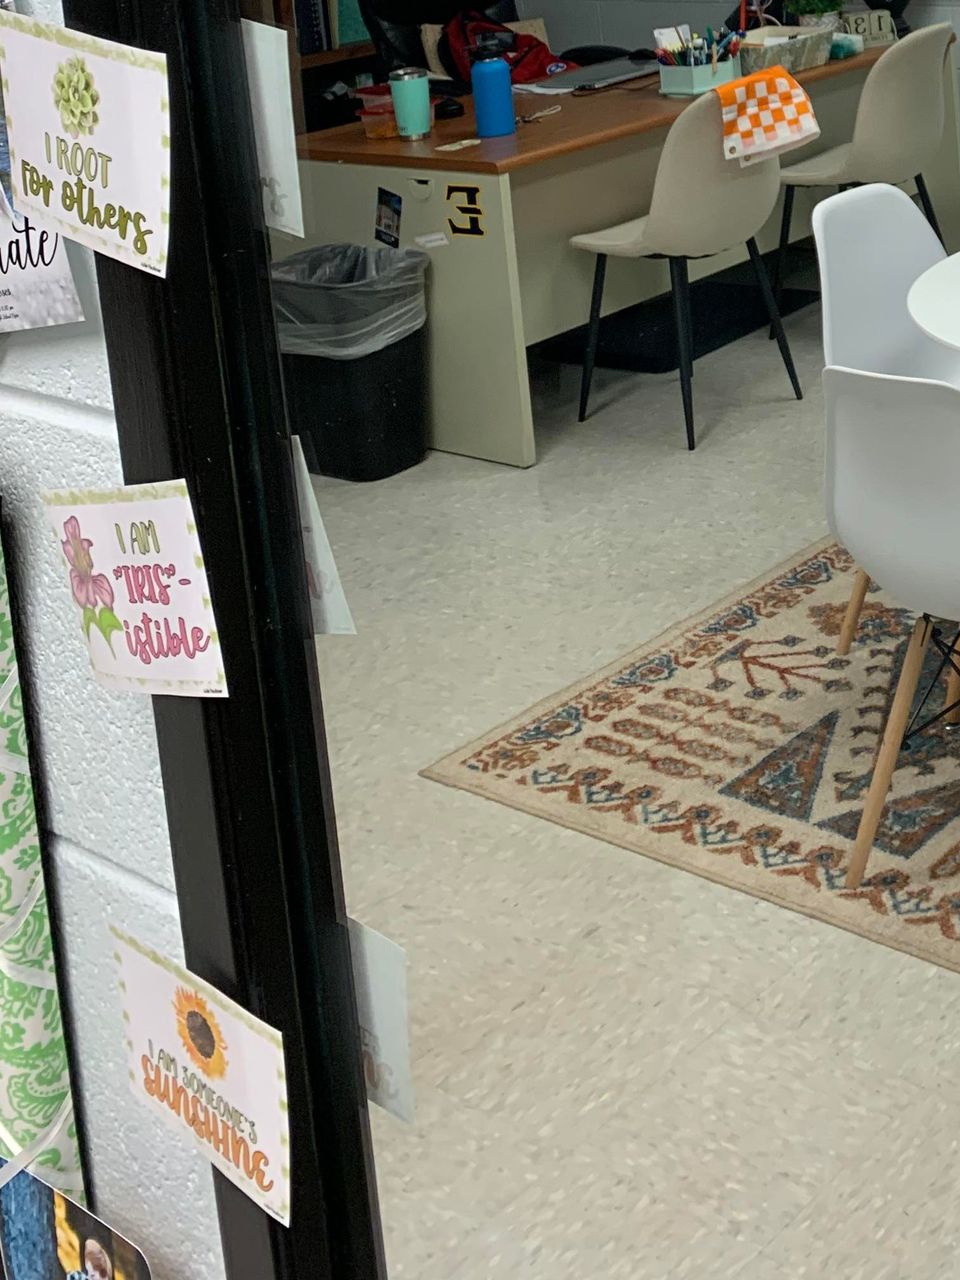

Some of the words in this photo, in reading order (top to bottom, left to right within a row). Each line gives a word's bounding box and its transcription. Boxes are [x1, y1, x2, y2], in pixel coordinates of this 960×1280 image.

[45, 132, 51, 163] I
[56, 136, 112, 188] ROOT
[61, 178, 153, 255] others
[115, 523, 126, 554] I
[130, 520, 160, 555] AM
[123, 612, 211, 665] istible
[158, 1048, 178, 1078] AM
